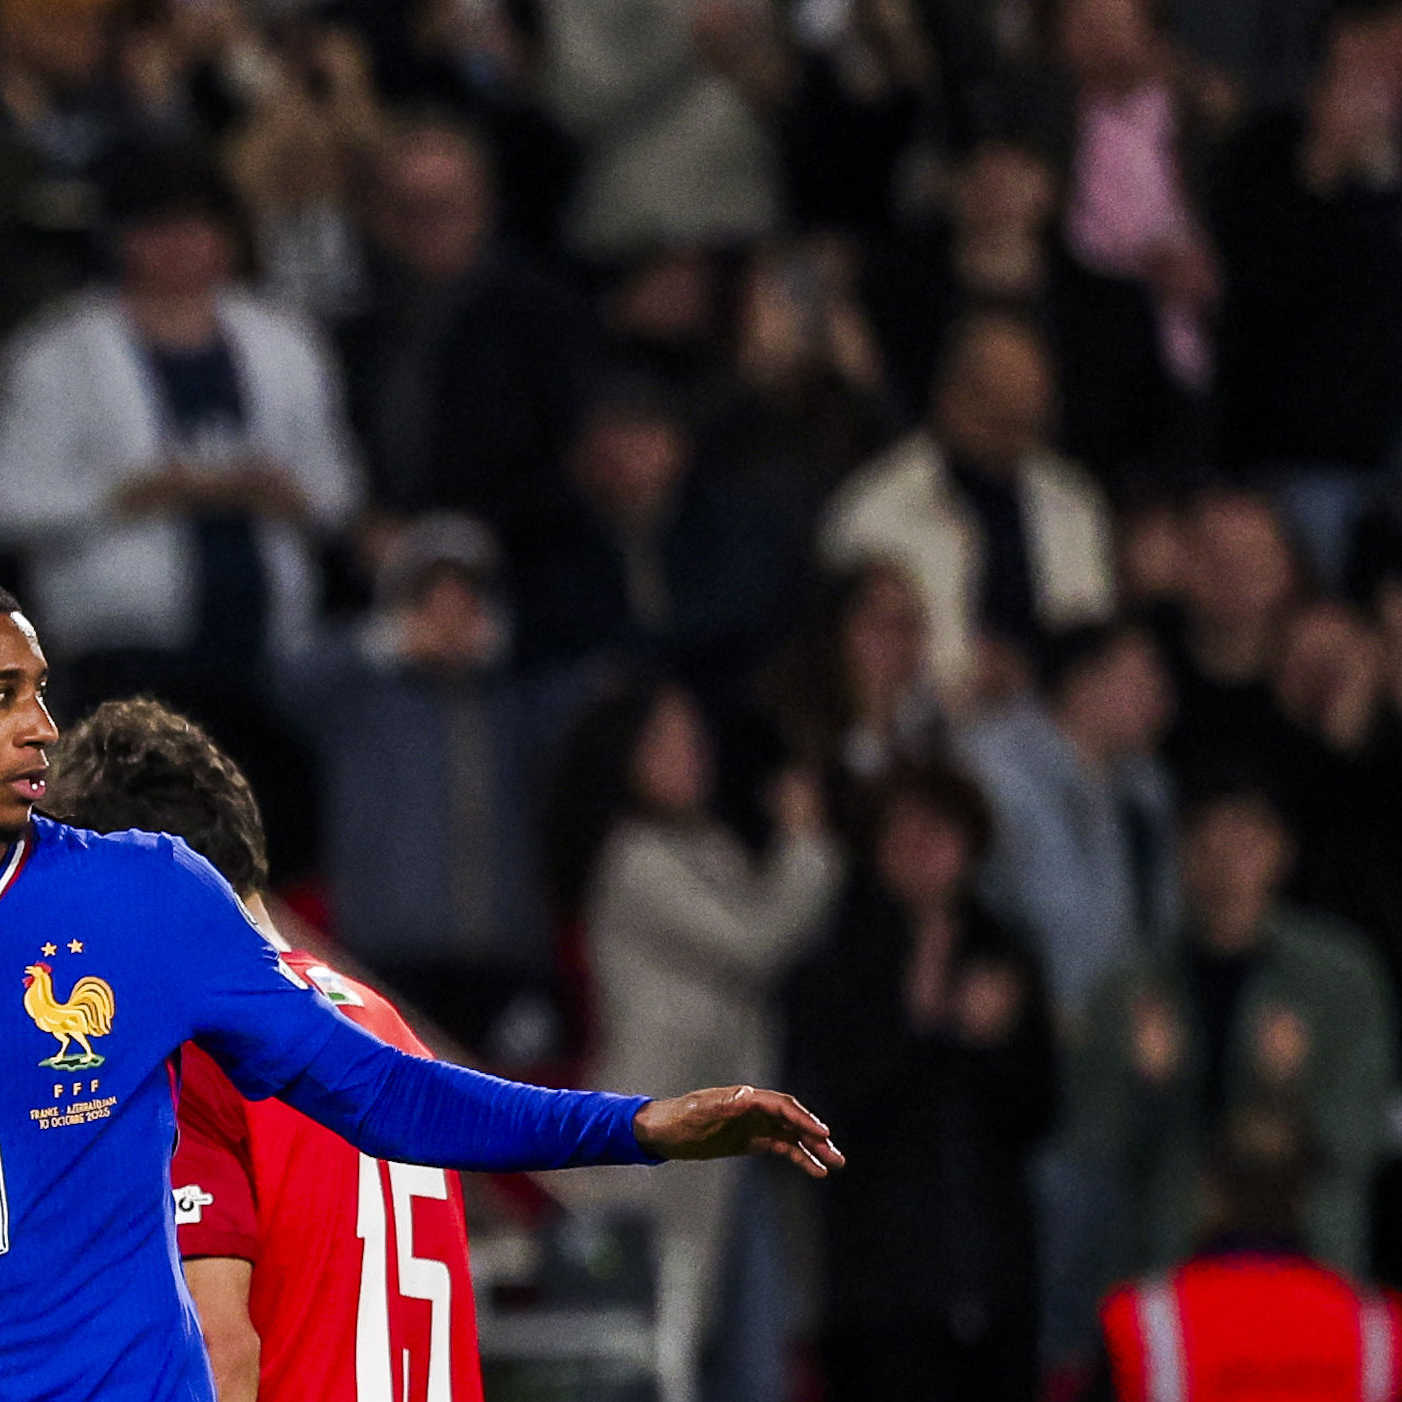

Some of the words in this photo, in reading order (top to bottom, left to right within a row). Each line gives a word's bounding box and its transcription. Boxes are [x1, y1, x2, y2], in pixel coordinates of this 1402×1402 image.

[30, 1106, 59, 1120] FRANCE
[39, 1119, 50, 1130] 10
[86, 1107, 111, 1122] 2025
